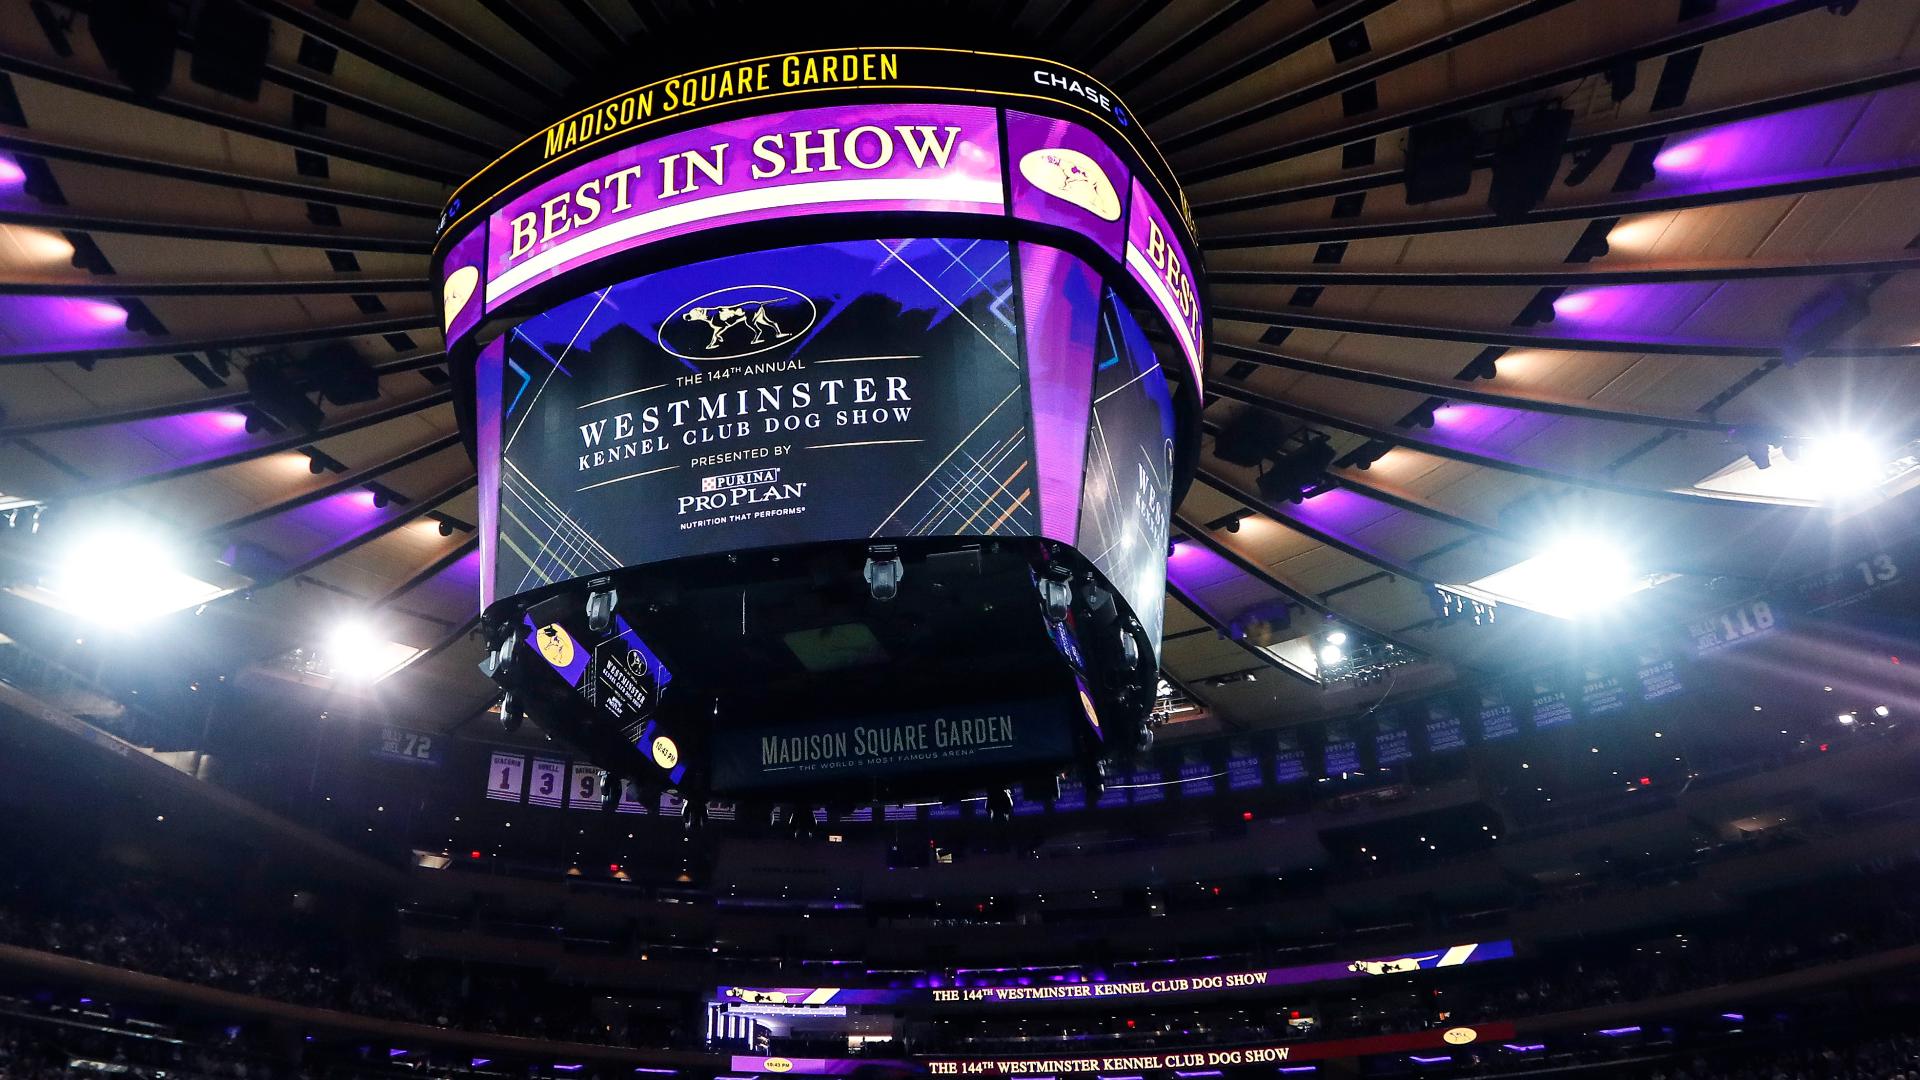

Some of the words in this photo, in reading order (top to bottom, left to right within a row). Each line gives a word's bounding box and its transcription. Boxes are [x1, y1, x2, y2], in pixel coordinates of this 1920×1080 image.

[1033, 70, 1111, 112] CHASE
[544, 90, 653, 159] MADISON
[663, 63, 770, 112] SQUARE
[782, 54, 898, 87] GARDEN
[509, 165, 641, 261] BEST
[657, 143, 729, 199] IN
[751, 125, 962, 180] SHOW
[1146, 216, 1199, 341] BEST
[676, 373, 703, 387] THE
[707, 367, 742, 382] 144TH
[743, 359, 806, 376] ANNUAL
[579, 376, 912, 448] WESTMINSTER
[579, 436, 669, 471] KENNEL
[682, 421, 750, 445] CLUB
[765, 413, 821, 433] DOG
[836, 407, 912, 426] SHOW
[691, 447, 769, 468] PRESENTED
[774, 445, 791, 456] BY
[717, 470, 774, 488] PURINA
[680, 516, 727, 530] NUTRITION
[729, 512, 752, 522] THAT
[1856, 553, 1898, 586] 13
[403, 734, 431, 758] 72
[762, 732, 847, 765] MADISON
[854, 724, 929, 756] SQUARE
[935, 715, 1013, 748] GARDEN
[868, 756, 893, 764] MOST
[899, 752, 938, 762] FAMOUS
[942, 749, 975, 757] ARENA
[500, 766, 510, 789] 1
[539, 773, 554, 795] 3
[580, 776, 595, 798] 9
[932, 990, 959, 1001] THE
[963, 988, 993, 1000] 144TH
[996, 985, 1091, 999] WESTMINSTER
[1095, 982, 1150, 996] KENNEL
[1152, 979, 1189, 993] CLUB
[1192, 976, 1223, 990] DOG
[1225, 972, 1267, 986] SHOW
[929, 1062, 957, 1074] THE
[962, 1061, 994, 1073] 144TH
[997, 1059, 1100, 1073] WESTMINSTER
[1103, 1056, 1162, 1071] KENNEL
[1165, 1053, 1205, 1067] CLUB
[1208, 1051, 1242, 1065] DOG
[1245, 1048, 1289, 1062] SHOW
